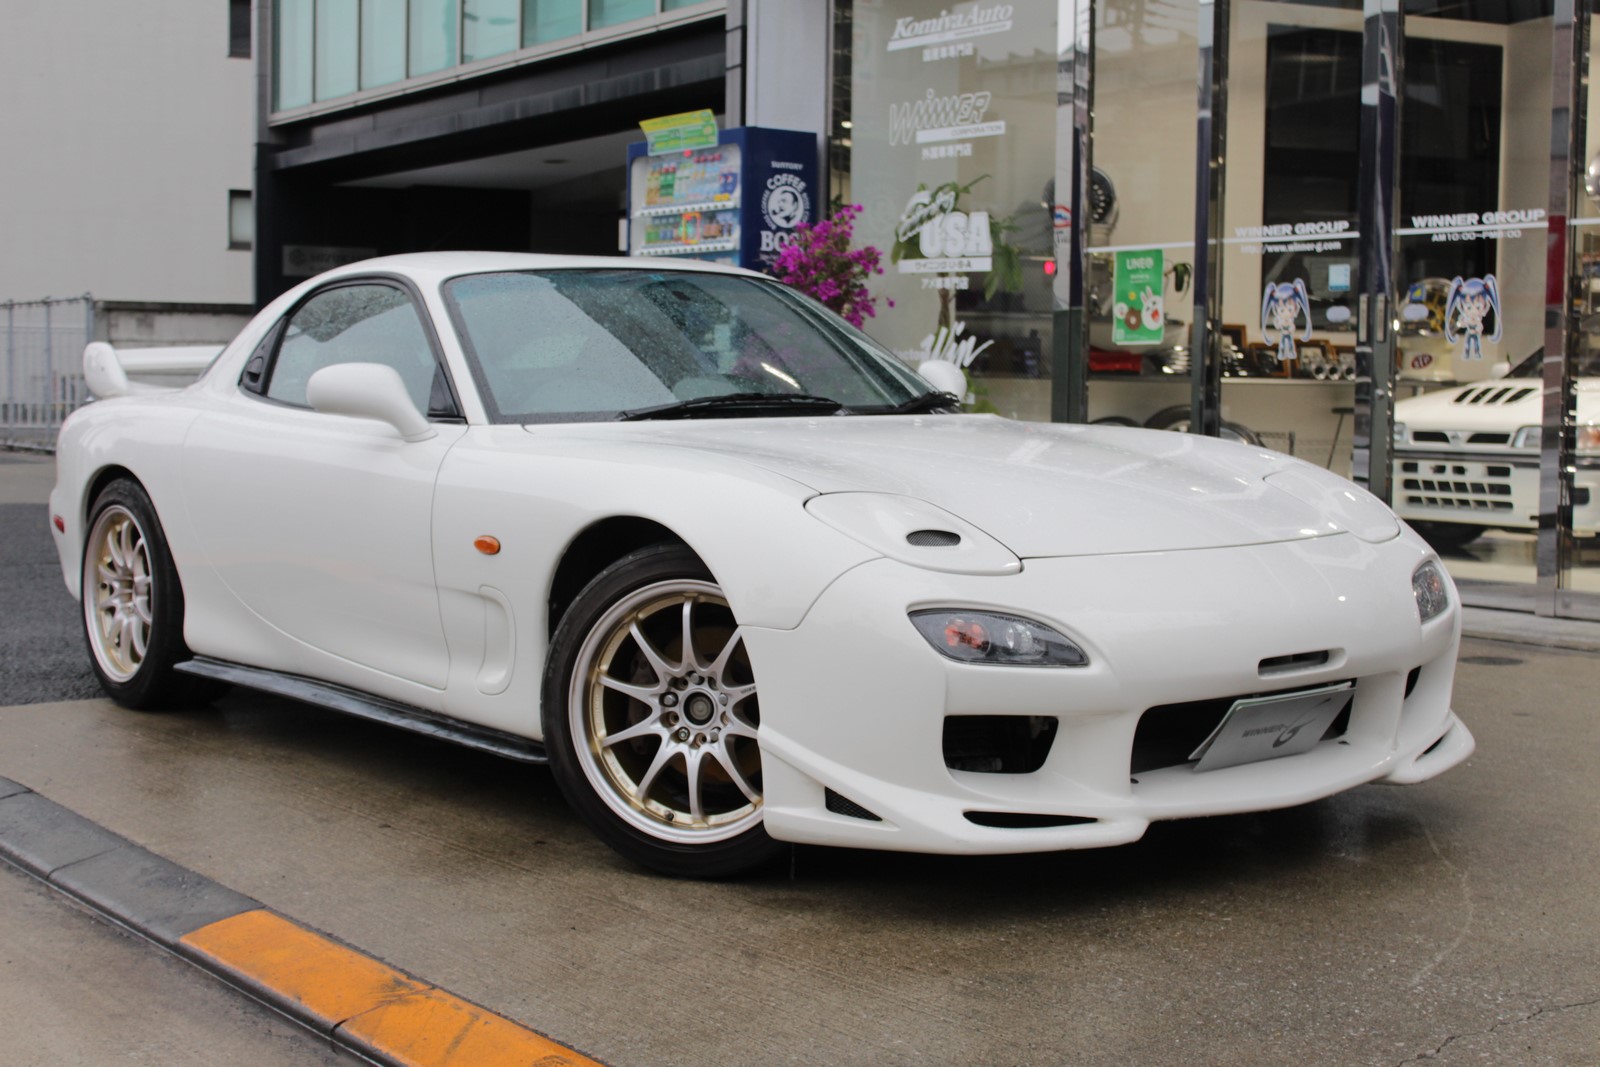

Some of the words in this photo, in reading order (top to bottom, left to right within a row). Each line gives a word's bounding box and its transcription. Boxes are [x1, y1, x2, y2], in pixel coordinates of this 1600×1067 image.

[766, 173, 808, 193] COFFEE
[1235, 223, 1292, 238] WINNER
[1294, 220, 1349, 235] GROUP
[1412, 213, 1480, 229] WINNER
[1482, 208, 1546, 225] GROUP
[760, 230, 806, 253] BO
[919, 211, 992, 258] USA
